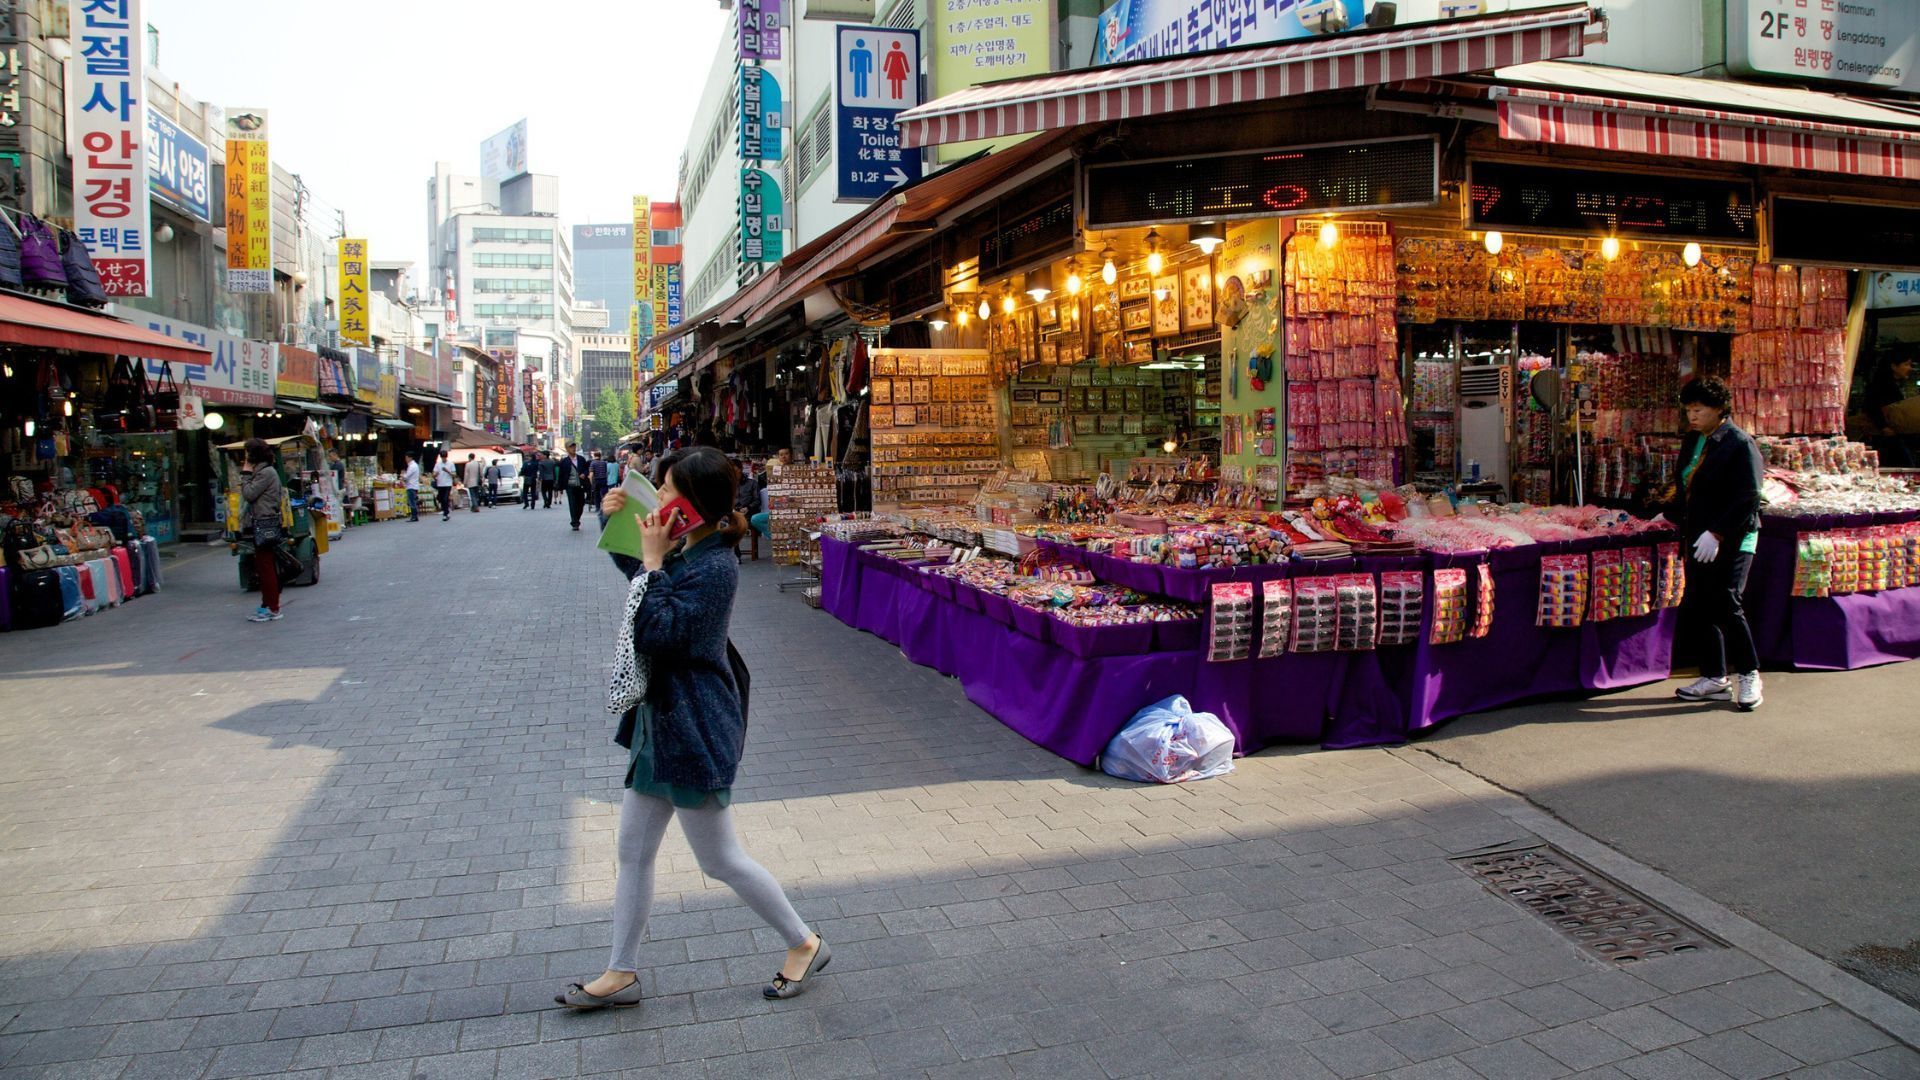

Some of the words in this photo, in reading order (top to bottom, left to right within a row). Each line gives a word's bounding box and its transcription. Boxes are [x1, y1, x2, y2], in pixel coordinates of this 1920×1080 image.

[1011, 14, 1032, 27] 대도
[1760, 10, 1789, 40] 2F
[1837, 29, 1886, 47] Lengddang
[975, 52, 1026, 67] 도깨비상가
[1794, 47, 1834, 71] 원렝땅
[1836, 58, 1901, 79] Onelengddang
[860, 133, 899, 147] Toilet
[858, 148, 901, 161] 化粧室
[82, 130, 138, 218] 안경
[179, 149, 206, 206] 안경
[851, 171, 880, 184] B1,2F
[744, 171, 762, 258] 수입명품
[79, 227, 142, 253] 콘택트
[95, 261, 140, 276] んせつ
[103, 279, 144, 294] がね
[1501, 371, 1509, 400] CCTV
